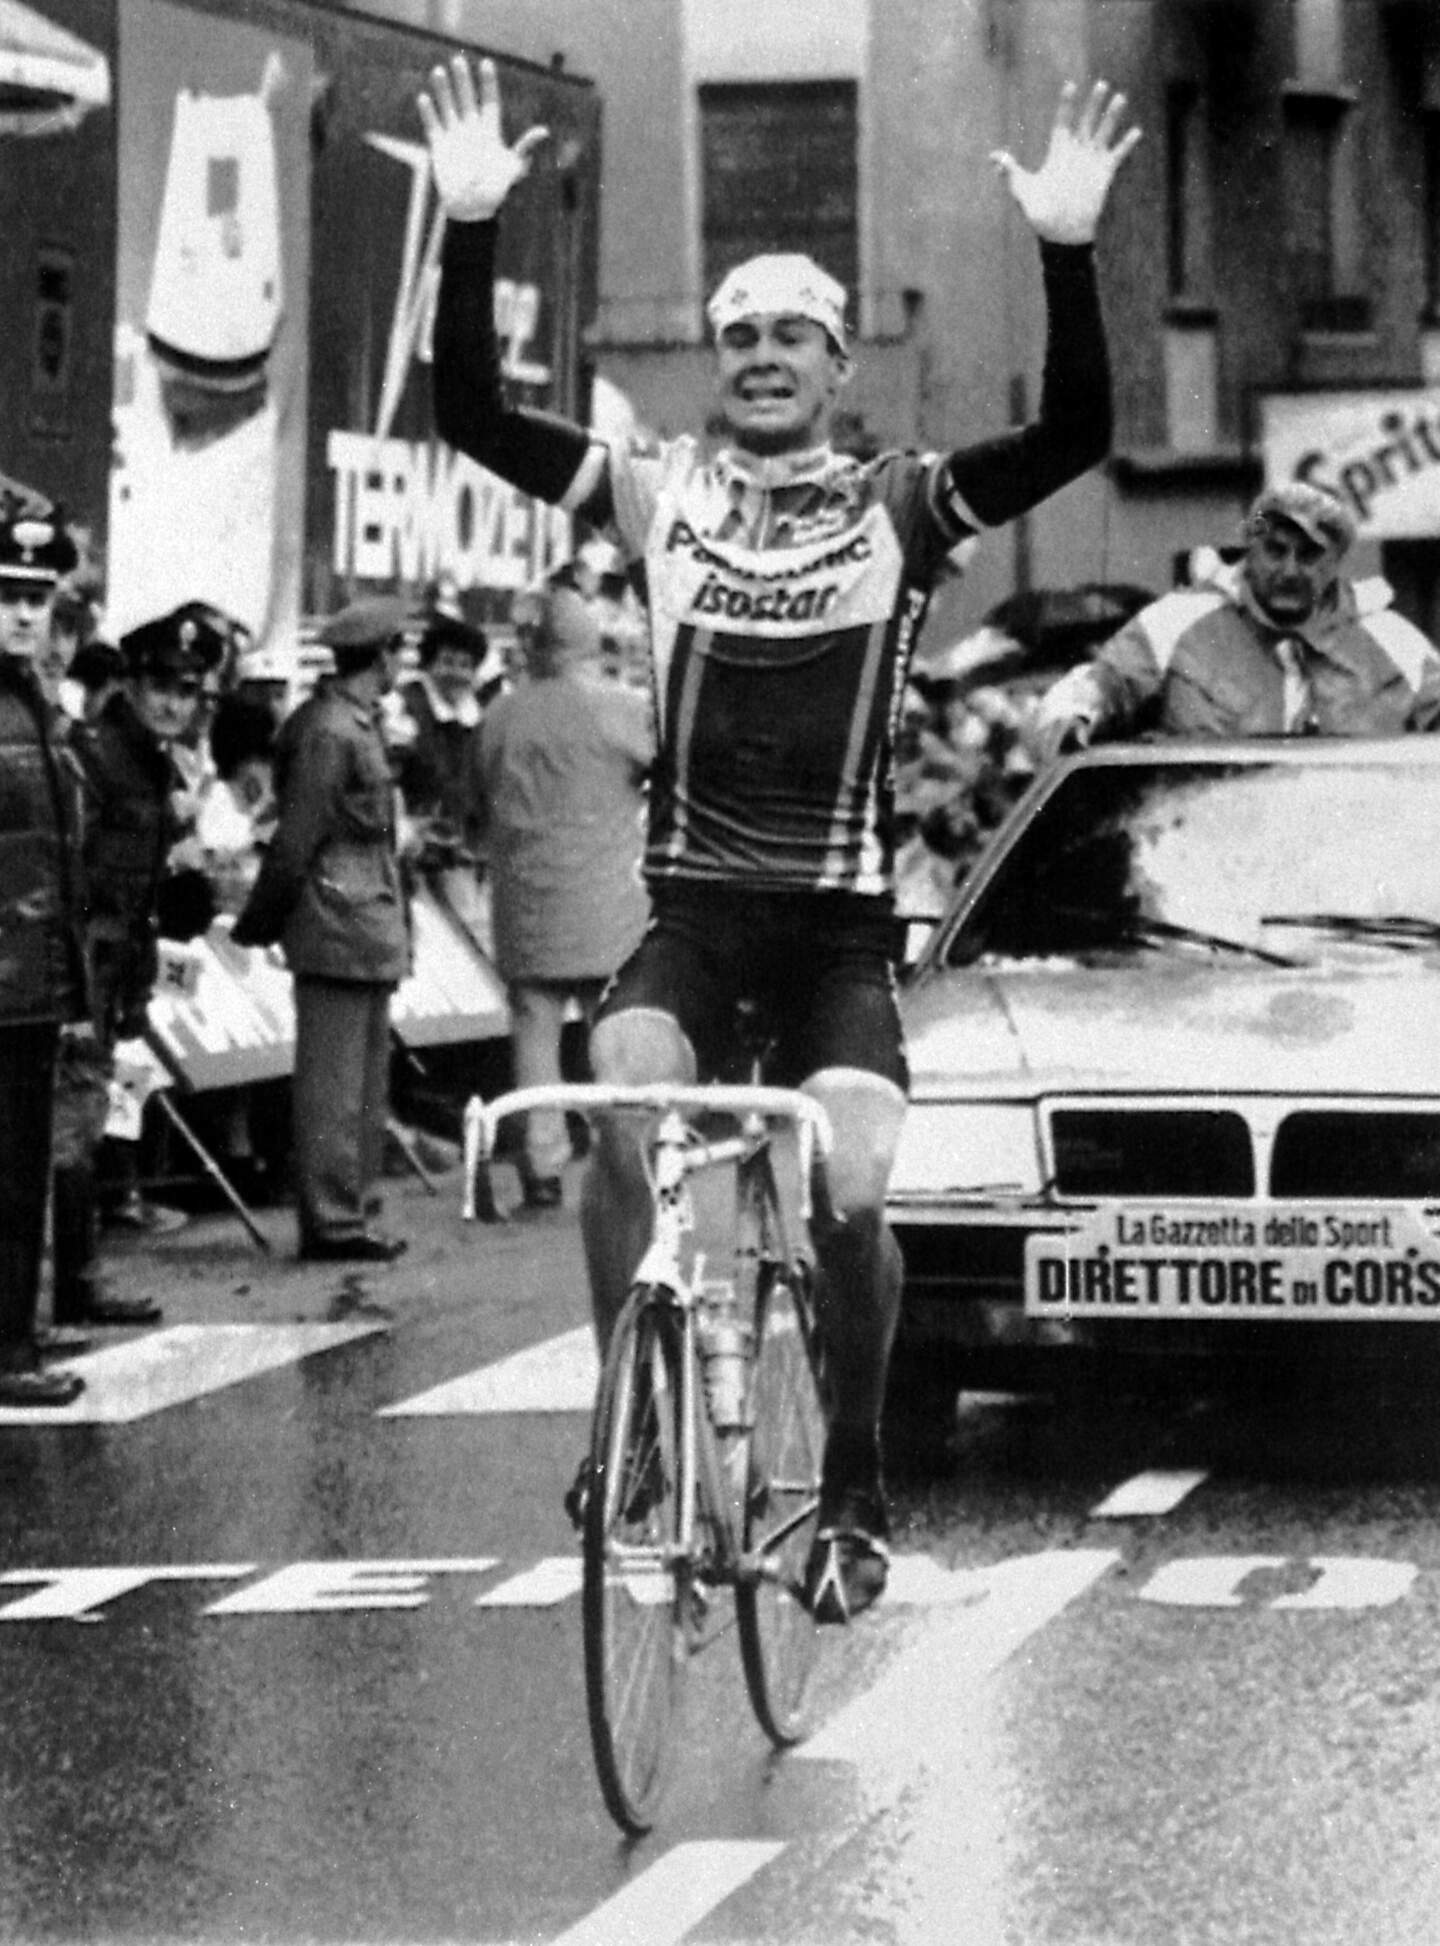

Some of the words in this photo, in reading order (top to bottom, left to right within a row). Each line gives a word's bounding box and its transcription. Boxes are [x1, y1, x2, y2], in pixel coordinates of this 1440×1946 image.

[692, 573, 838, 621] isostar
[1117, 1214, 1145, 1246] La
[1151, 1214, 1255, 1247] Gazzetta
[1265, 1216, 1318, 1248] dello
[1324, 1216, 1390, 1250] Sport
[1038, 1258, 1286, 1305] DIRETTORE
[1292, 1280, 1318, 1305] DI
[1325, 1259, 1440, 1305] CORS
